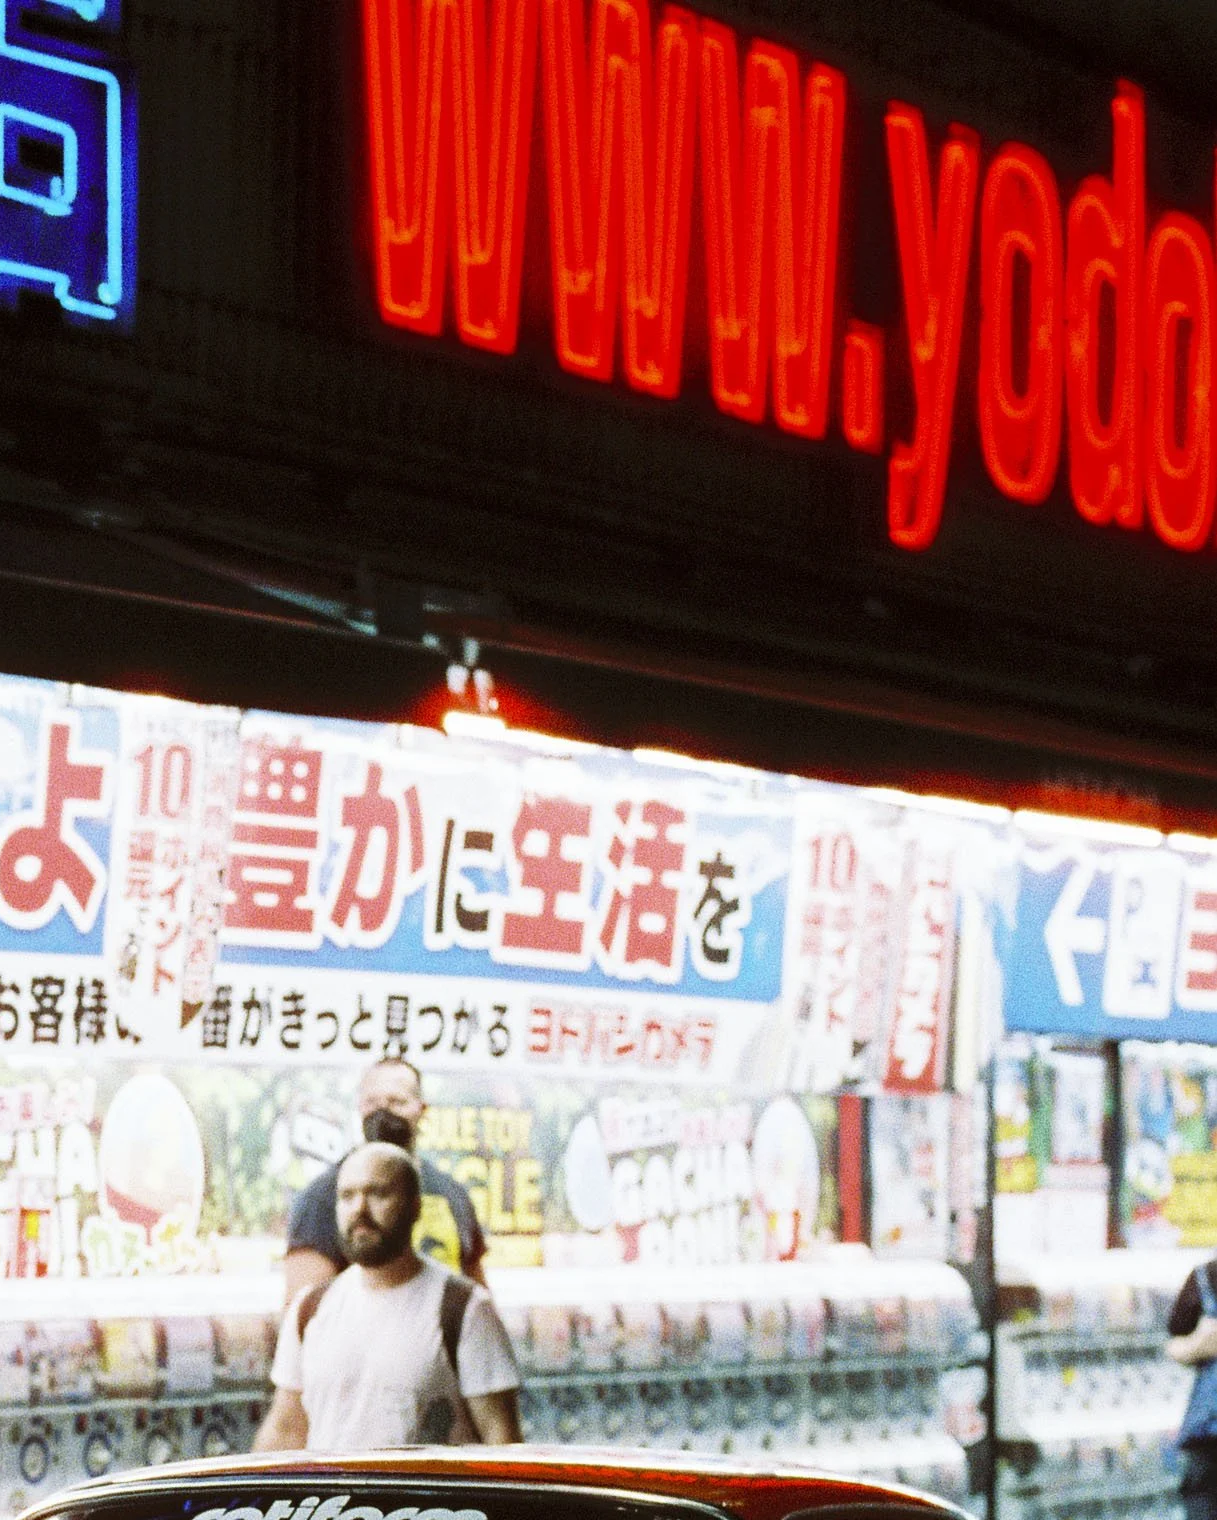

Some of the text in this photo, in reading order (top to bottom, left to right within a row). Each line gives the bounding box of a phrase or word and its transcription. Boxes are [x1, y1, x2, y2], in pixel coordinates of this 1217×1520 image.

[362, 0, 1217, 552] www.yodo
[133, 743, 193, 820] 10
[529, 1004, 716, 1066] ヨドバシカメラ
